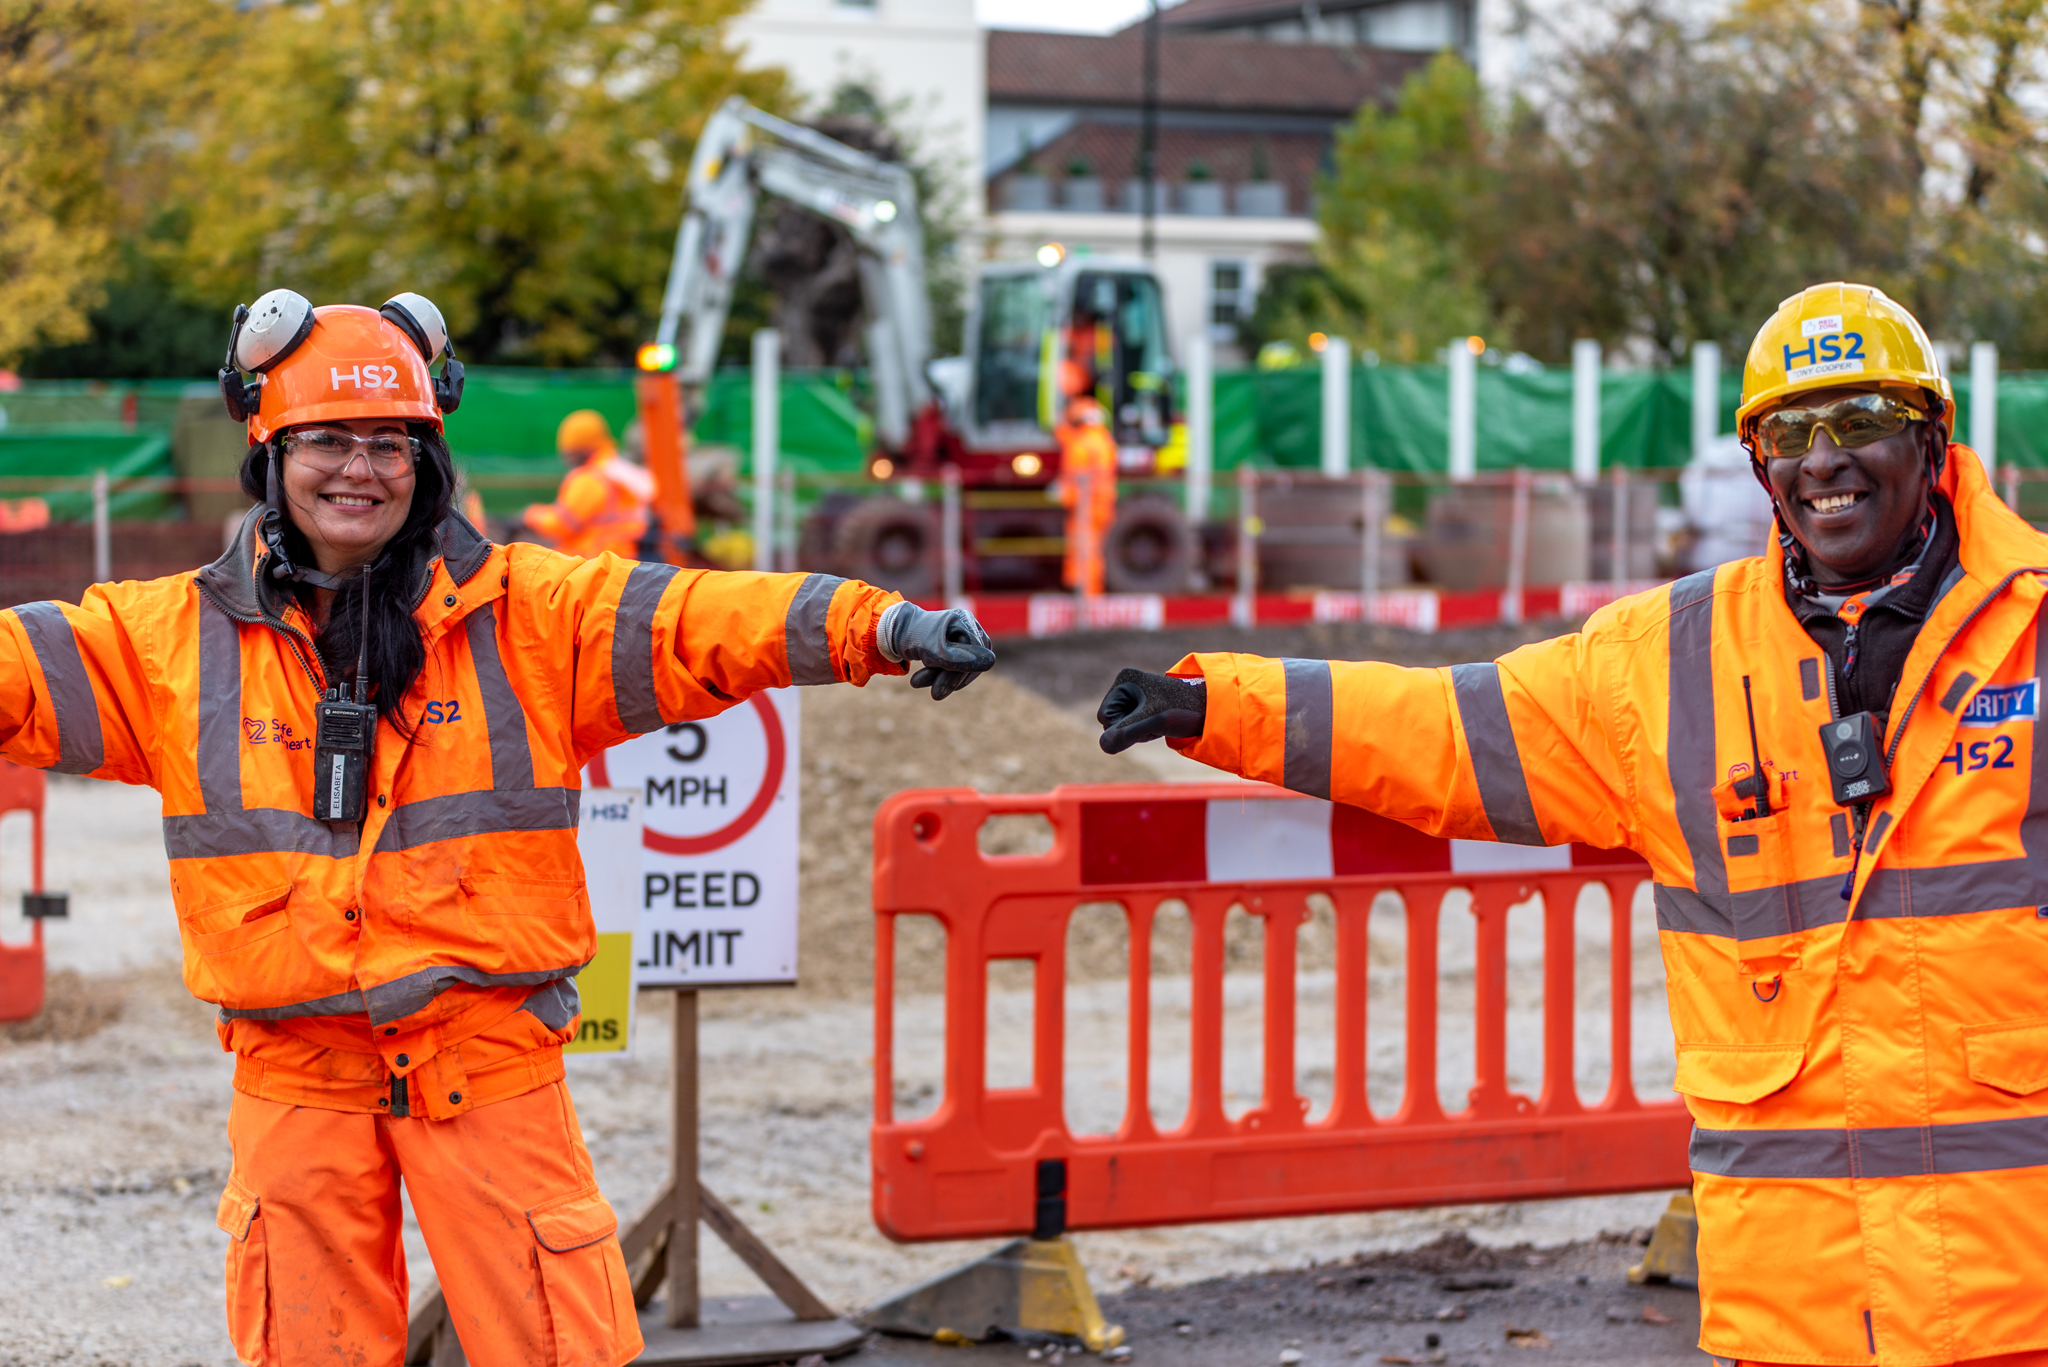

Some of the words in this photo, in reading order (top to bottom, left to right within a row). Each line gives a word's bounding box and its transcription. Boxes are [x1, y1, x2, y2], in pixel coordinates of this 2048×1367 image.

[1818, 323, 1838, 331] ZONE
[1783, 332, 1866, 372] HS2
[330, 364, 400, 391] HS2
[1815, 362, 1852, 374] COOPER
[418, 699, 462, 725] S2
[1963, 688, 2028, 718] URITY
[271, 718, 293, 737] Sfe
[665, 721, 709, 763] 5
[1940, 735, 2015, 776] HS2
[333, 764, 343, 809] ELISABETA
[1778, 769, 1799, 781] art
[1846, 780, 1868, 791] VIDEO
[645, 776, 728, 806] MPH
[1848, 787, 1870, 798] AUDIO
[590, 803, 630, 820] HS2
[644, 871, 762, 910] PEED
